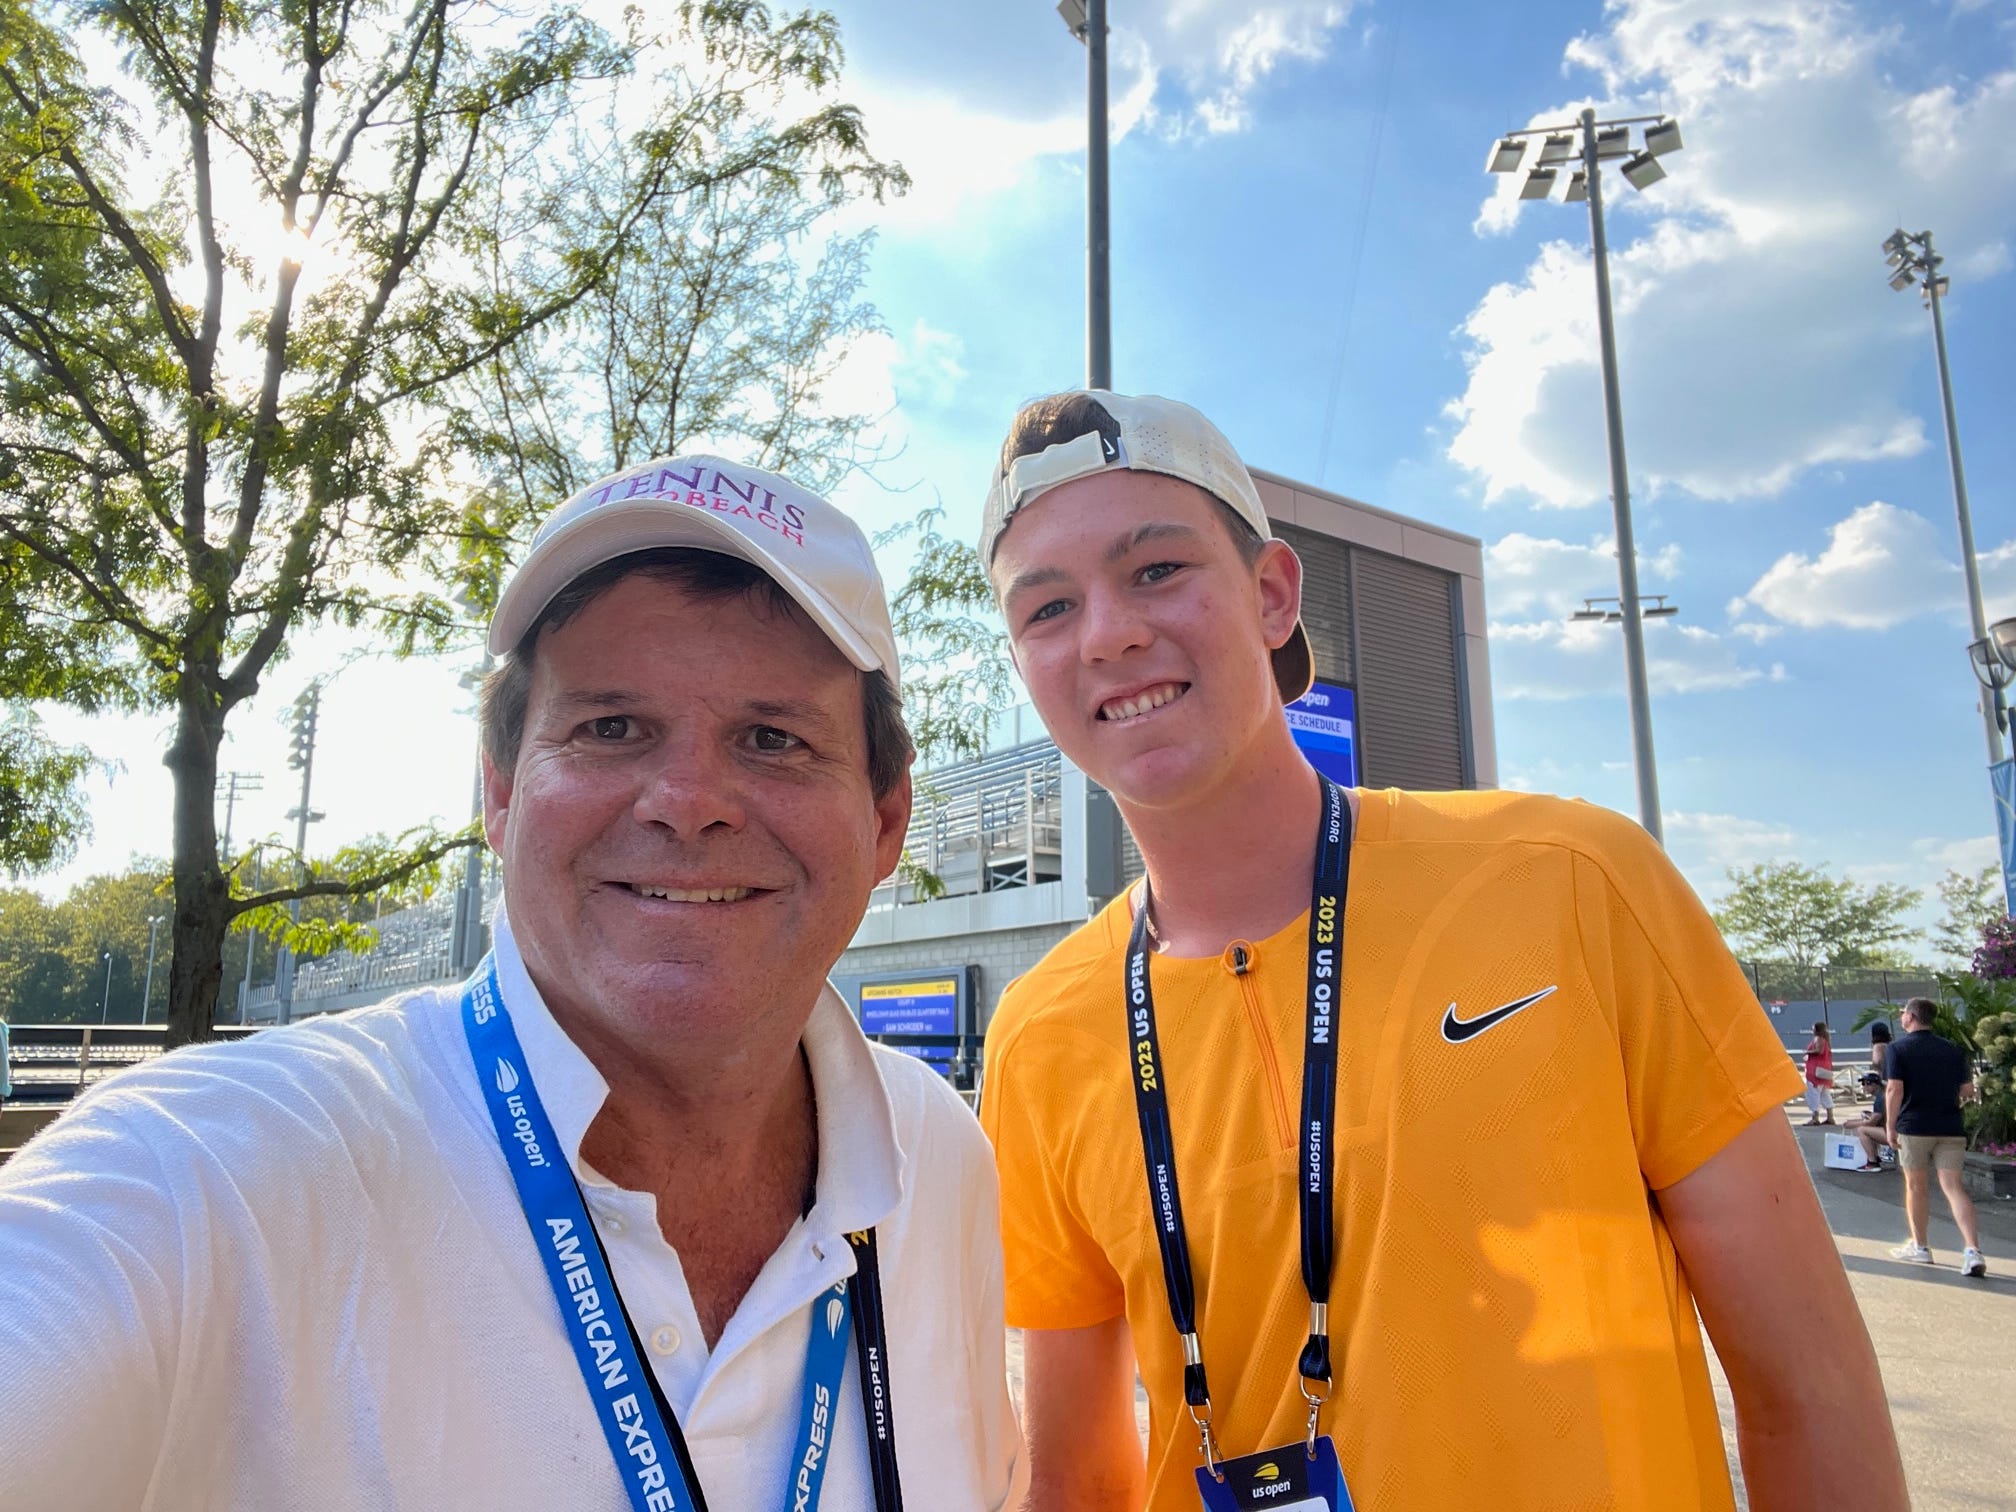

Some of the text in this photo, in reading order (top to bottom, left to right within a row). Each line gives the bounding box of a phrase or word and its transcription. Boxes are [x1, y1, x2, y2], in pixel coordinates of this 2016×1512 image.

[590, 466, 805, 531] TENNIS
[685, 490, 805, 548] BEACH
[1298, 714, 1342, 733] SCHEDULE
[1312, 895, 1337, 1044] 2023 US OPEN
[1131, 951, 1158, 1092] 2023 US OPEN
[506, 1094, 546, 1168] us open
[1310, 1119, 1321, 1194] #USOPEN
[1156, 1163, 1175, 1233] #USOPEN
[546, 1218, 629, 1390] AMERICAN
[868, 1346, 887, 1441] #USOPEN
[1252, 1481, 1291, 1499] us open
